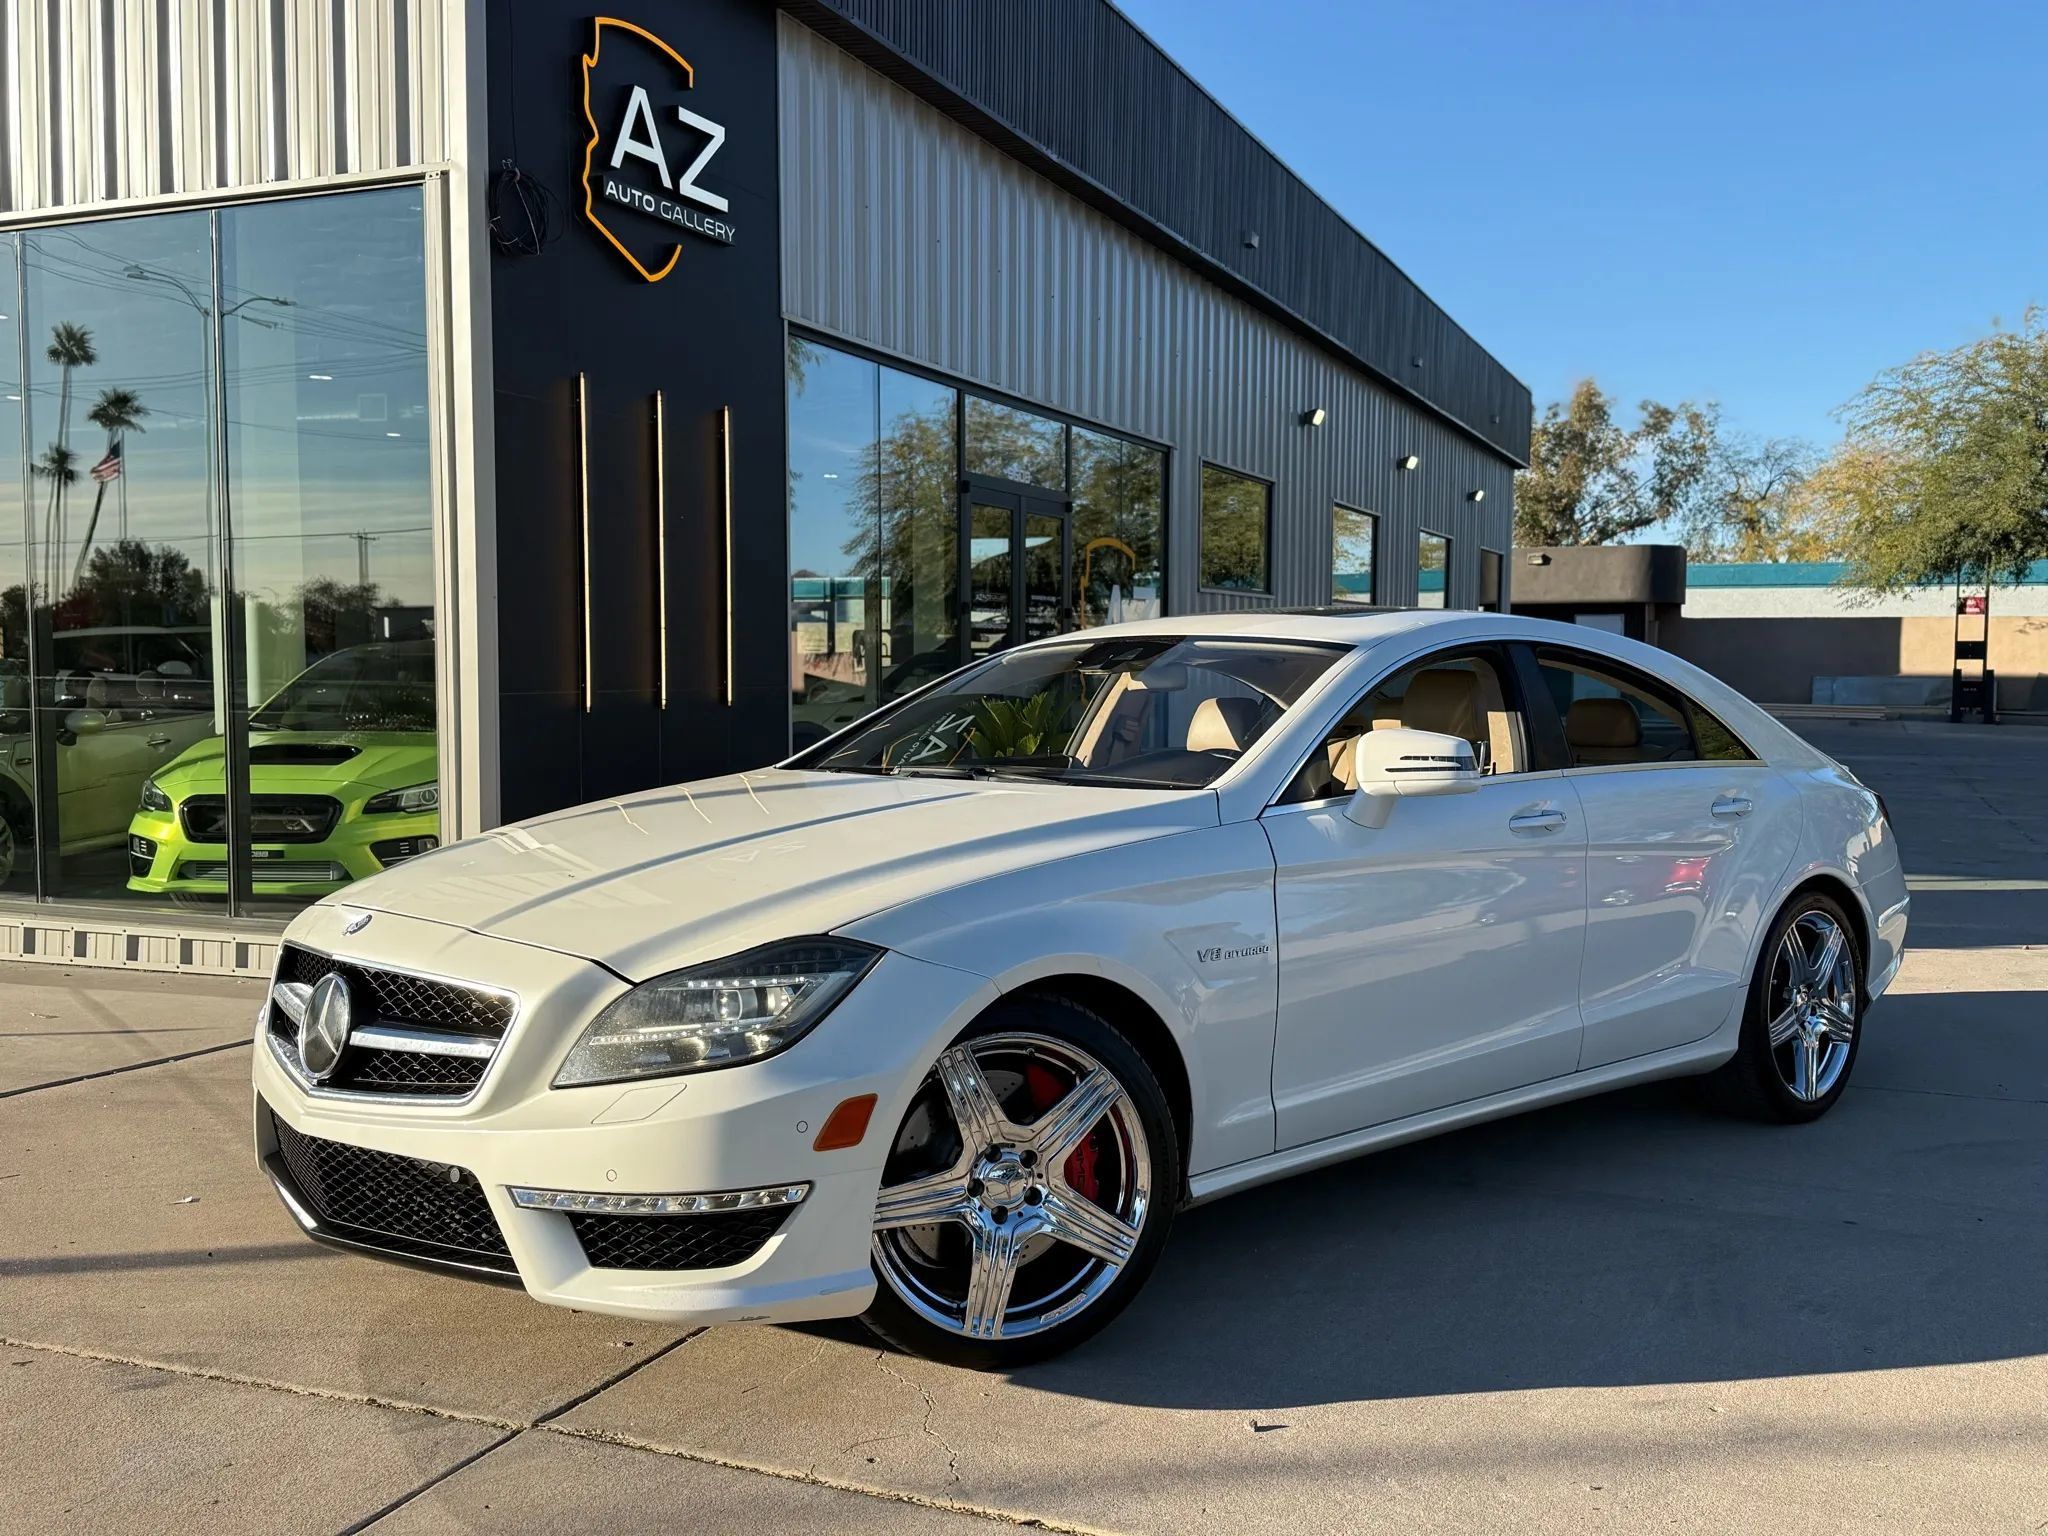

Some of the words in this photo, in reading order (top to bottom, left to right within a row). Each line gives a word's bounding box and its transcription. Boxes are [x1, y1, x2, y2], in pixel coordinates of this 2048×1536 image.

[610, 84, 729, 213] AZ
[605, 180, 656, 213] AUTO
[659, 202, 736, 242] GALLERY
